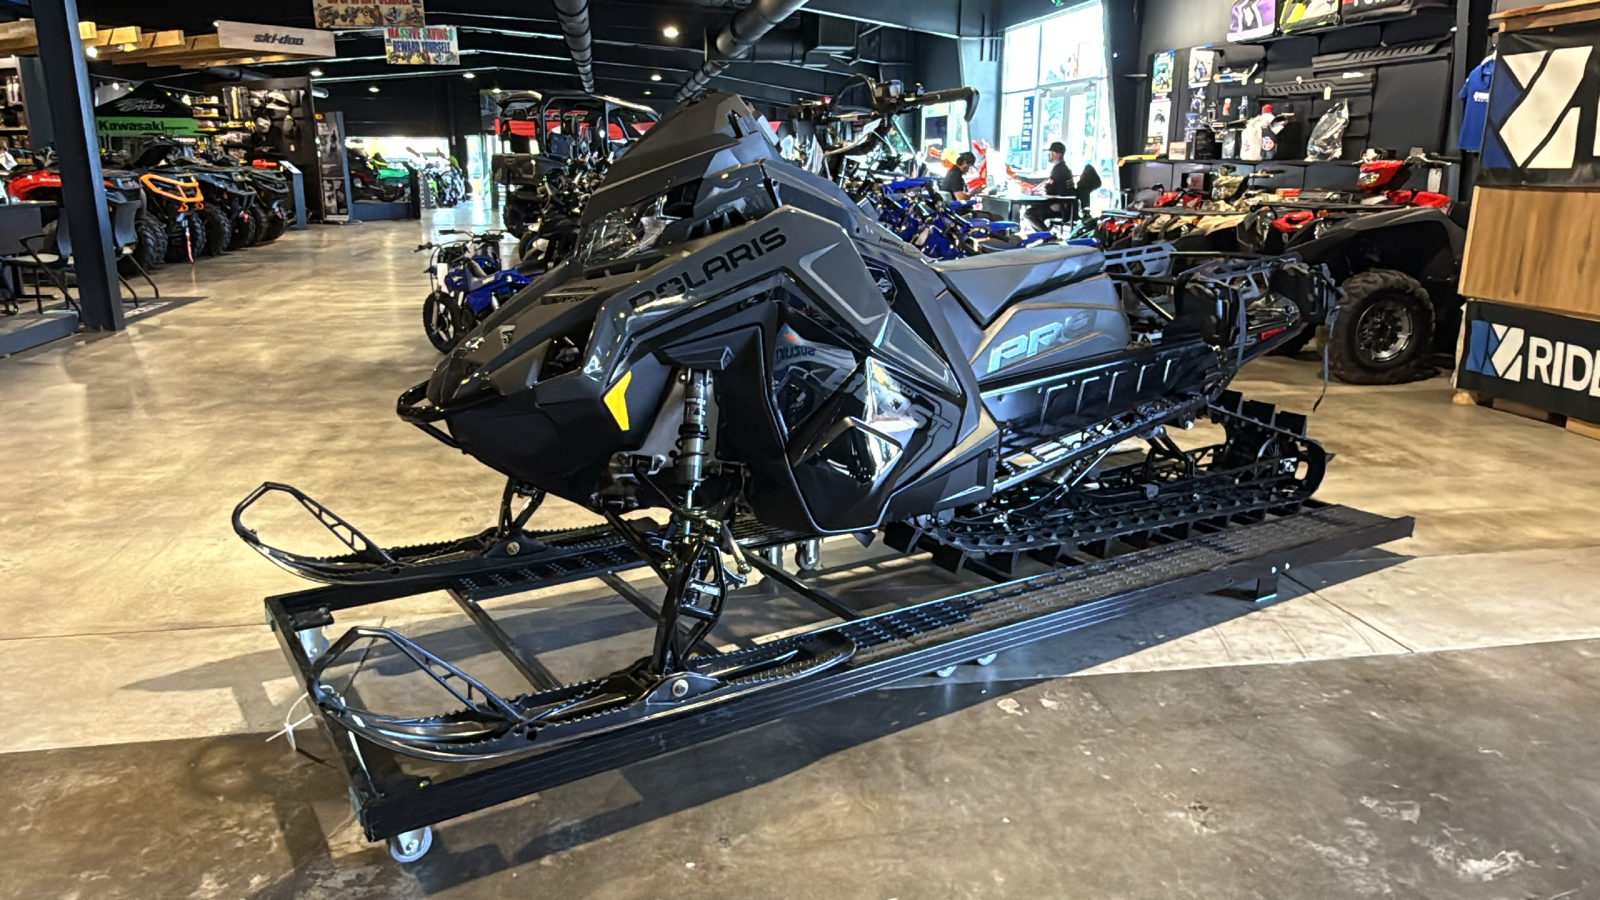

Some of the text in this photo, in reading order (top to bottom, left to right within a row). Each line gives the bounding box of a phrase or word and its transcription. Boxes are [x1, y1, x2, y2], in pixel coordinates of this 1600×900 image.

[253, 34, 304, 46] ski-doo
[98, 120, 164, 131] Kawasaki
[629, 226, 788, 310] POLARIS
